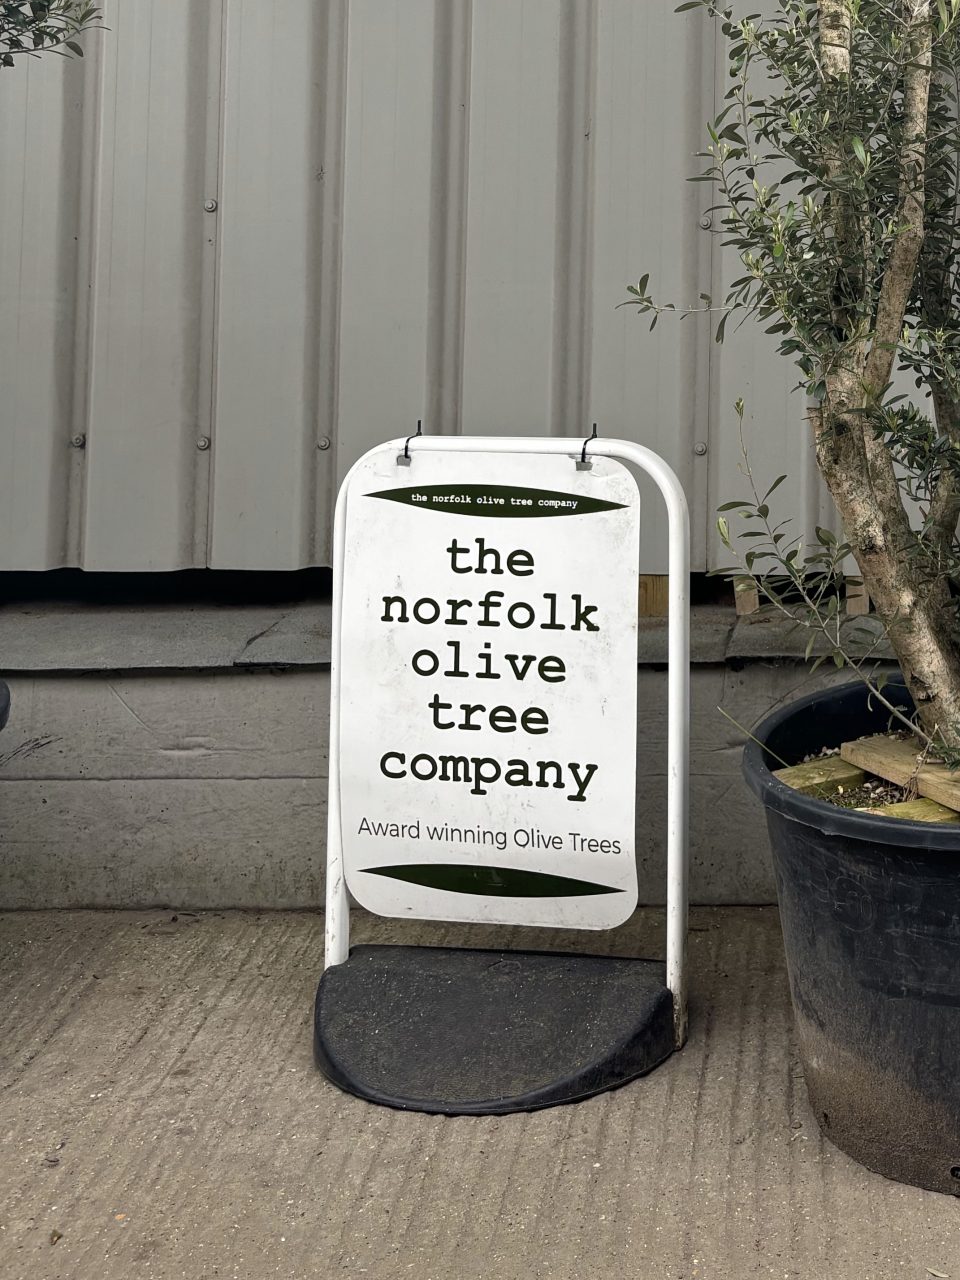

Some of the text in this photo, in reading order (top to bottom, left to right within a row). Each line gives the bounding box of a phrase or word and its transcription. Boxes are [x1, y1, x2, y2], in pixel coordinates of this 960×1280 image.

[411, 493, 578, 509] the norfolk olive tree company
[447, 538, 534, 577] the
[381, 591, 601, 632] norfolk
[411, 641, 566, 684] olive
[428, 693, 549, 735] tree
[380, 751, 599, 802] company
[357, 817, 622, 855] Award winning Olive Trees
